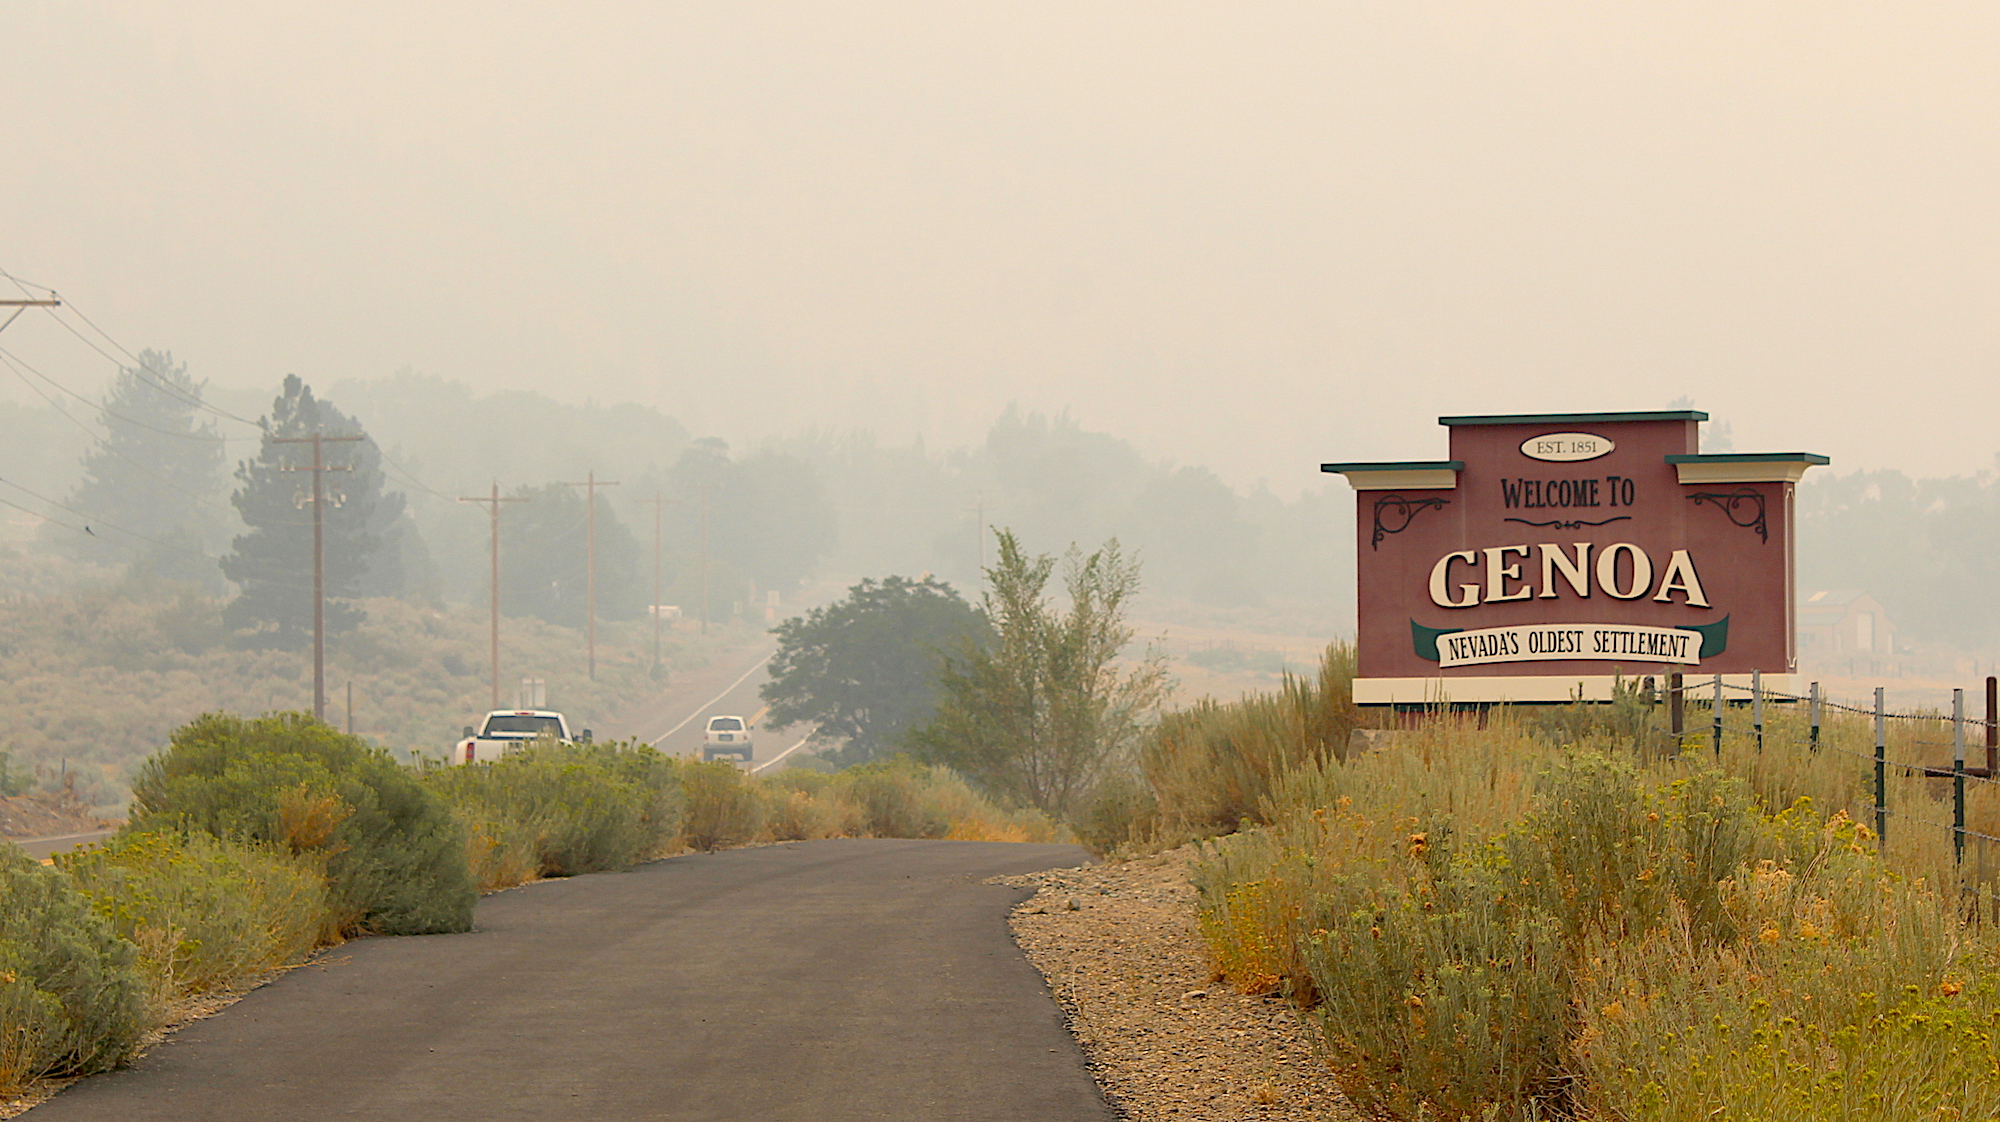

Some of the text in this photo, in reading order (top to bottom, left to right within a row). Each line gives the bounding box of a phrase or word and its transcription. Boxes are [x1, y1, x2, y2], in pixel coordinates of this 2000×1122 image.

[1537, 440, 1597, 454] EST. 1851
[1501, 476, 1634, 509] WELCOME TO
[1428, 542, 1711, 609] GENOA
[1448, 630, 1690, 660] NEVADA'S OLDEST SETTLEMENT
